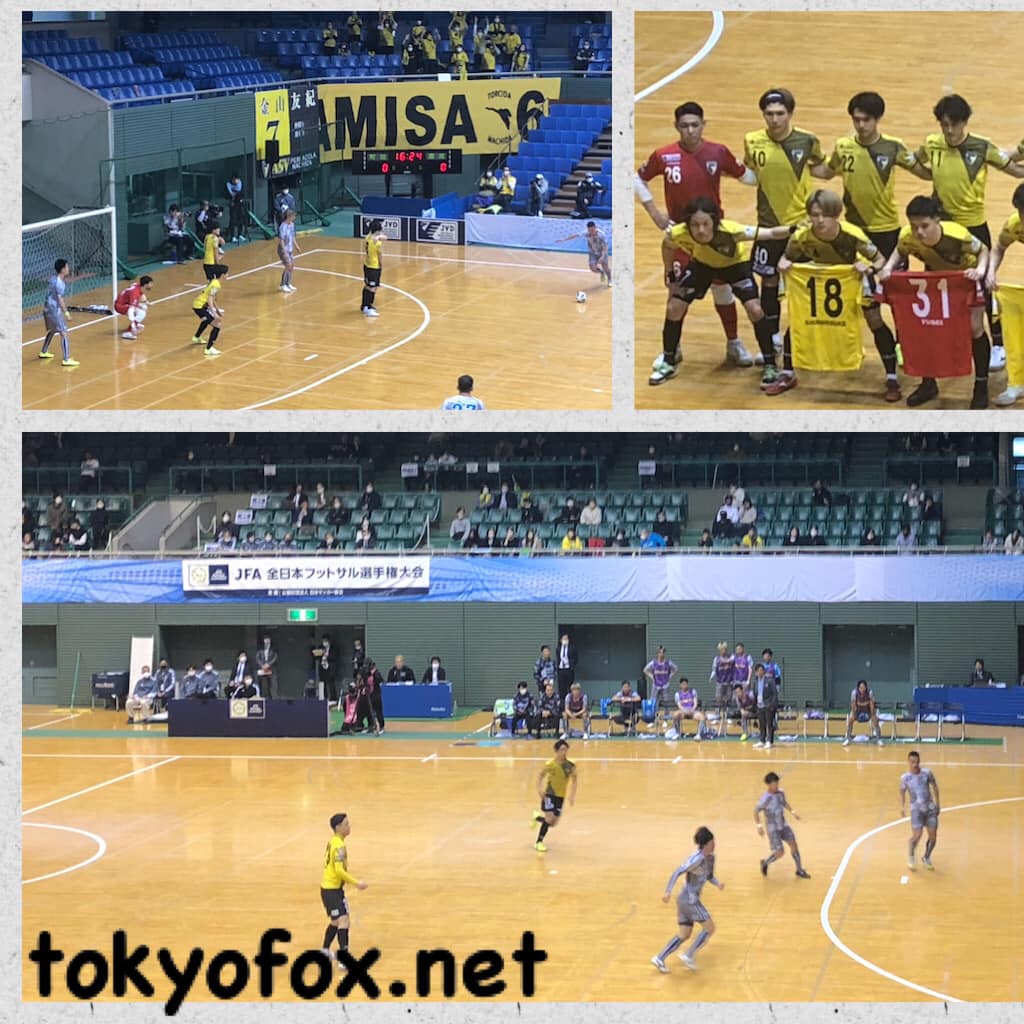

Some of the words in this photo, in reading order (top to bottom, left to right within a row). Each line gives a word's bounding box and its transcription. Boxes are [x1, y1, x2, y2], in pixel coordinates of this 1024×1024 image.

[394, 151, 424, 163] 16:24
[841, 154, 856, 173] 22
[664, 166, 681, 184] 26
[806, 276, 844, 318] 18
[908, 277, 950, 319] 31
[234, 567, 262, 581] JFA
[267, 564, 425, 581] 全日本フットサル選手権大会
